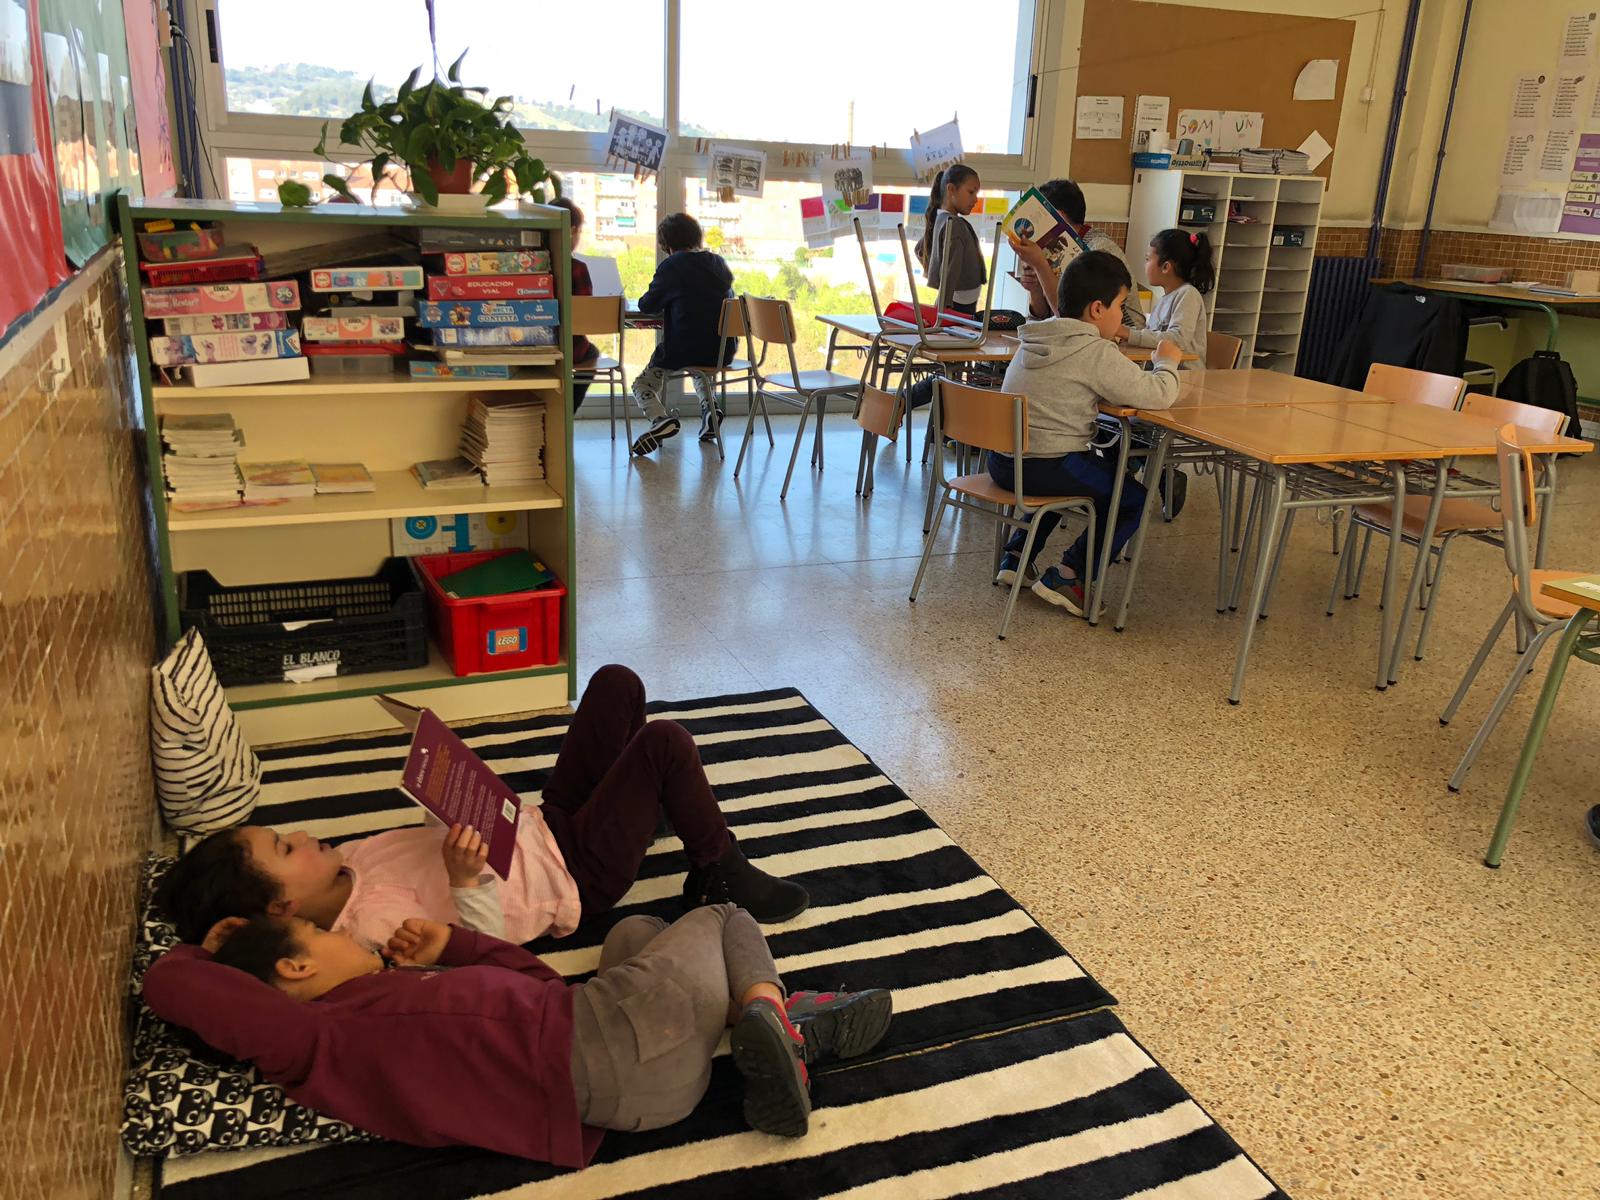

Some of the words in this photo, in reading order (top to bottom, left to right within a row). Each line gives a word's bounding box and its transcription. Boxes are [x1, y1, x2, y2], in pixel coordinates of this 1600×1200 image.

[1179, 114, 1213, 136] SOM
[497, 634, 518, 646] LEGO
[283, 653, 296, 665] EL
[299, 649, 341, 664] BLANCO
